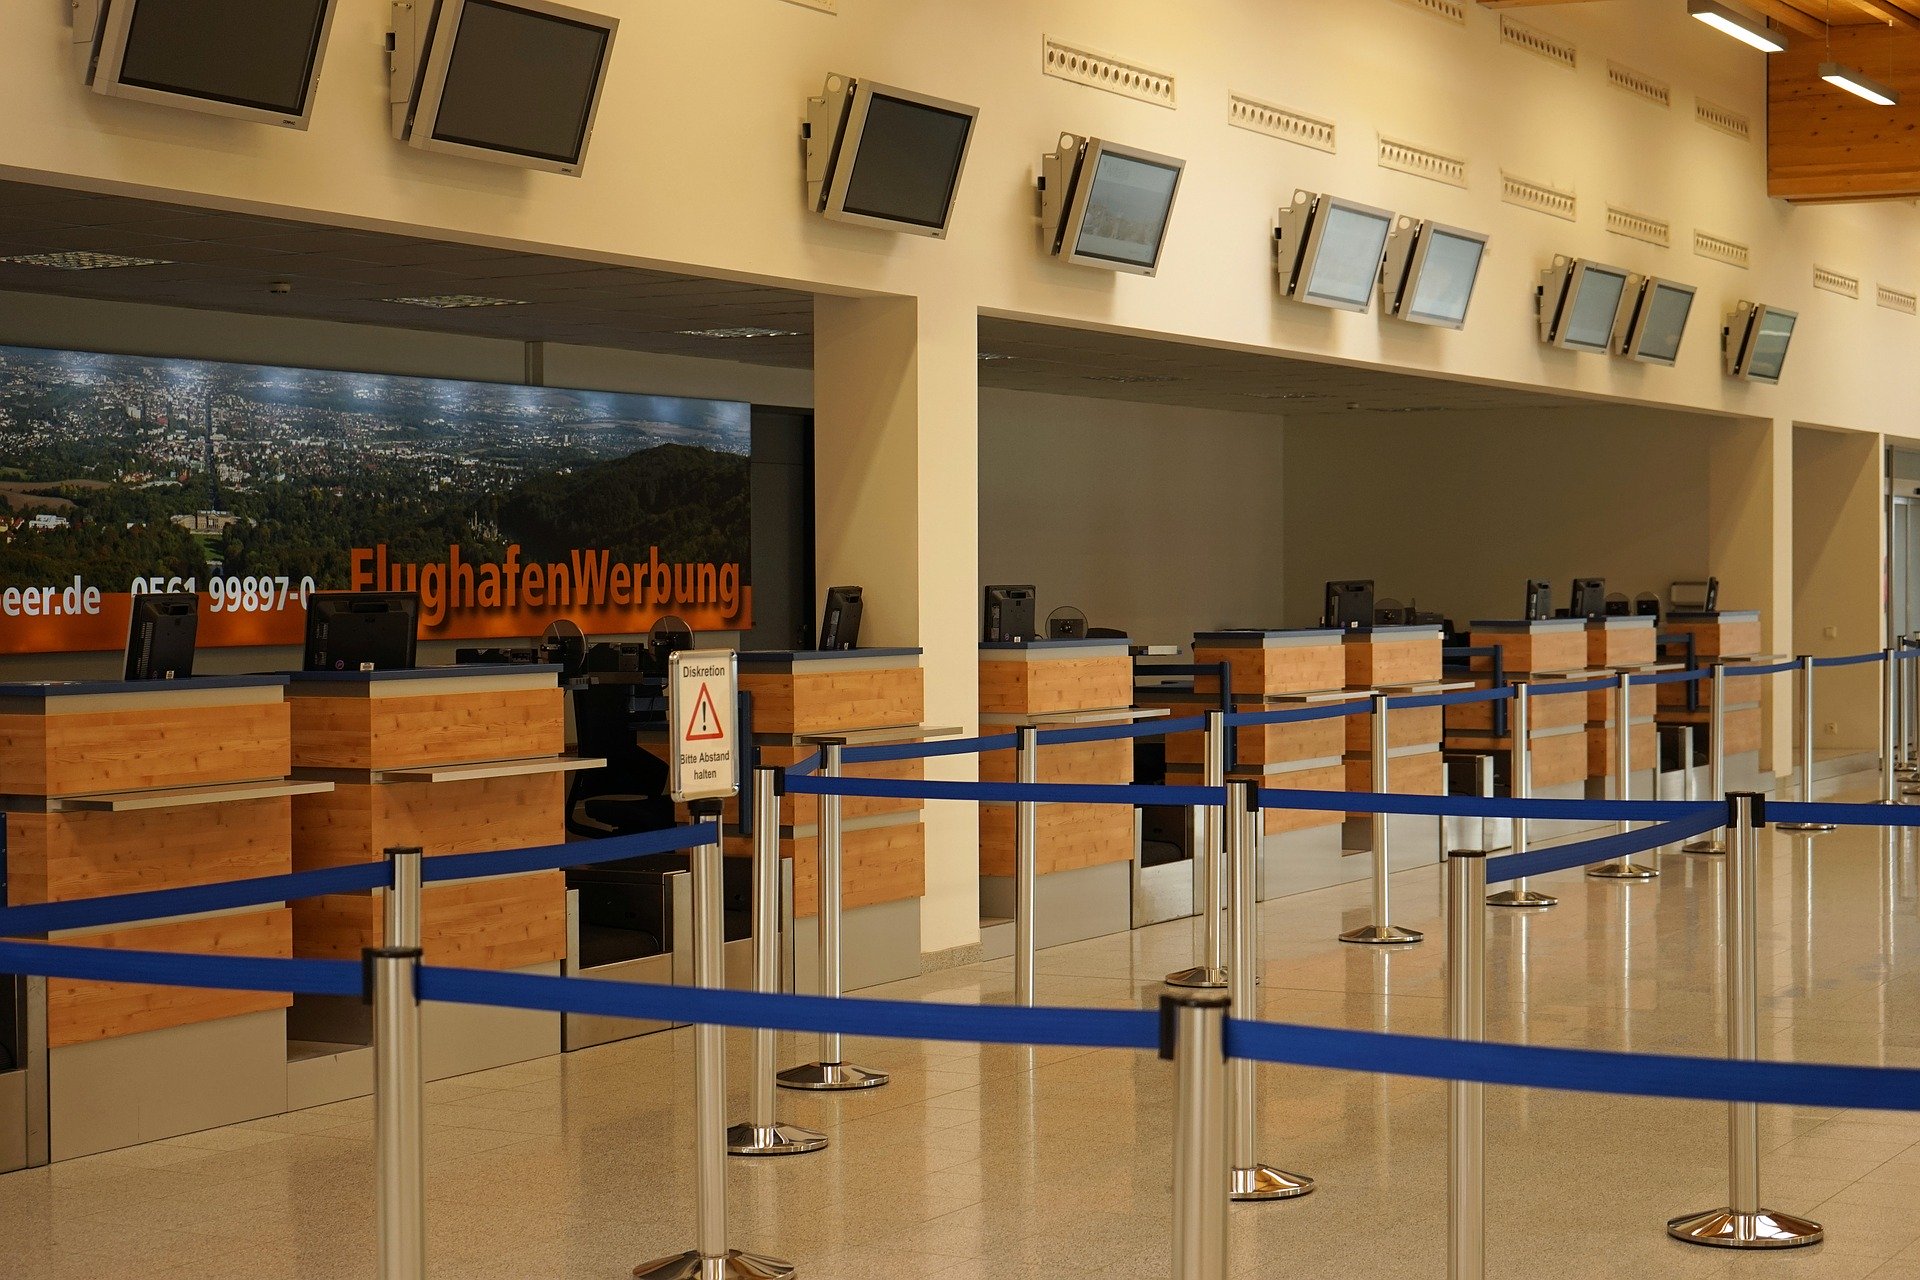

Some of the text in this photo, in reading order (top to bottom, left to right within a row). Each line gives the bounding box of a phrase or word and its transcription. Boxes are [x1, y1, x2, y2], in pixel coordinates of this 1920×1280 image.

[350, 543, 740, 626] FlughafenWerbung
[208, 576, 316, 612] 99897-0
[683, 666, 725, 678] Diskretion
[680, 751, 730, 765] Bitte Abstand
[693, 769, 717, 780] halten
